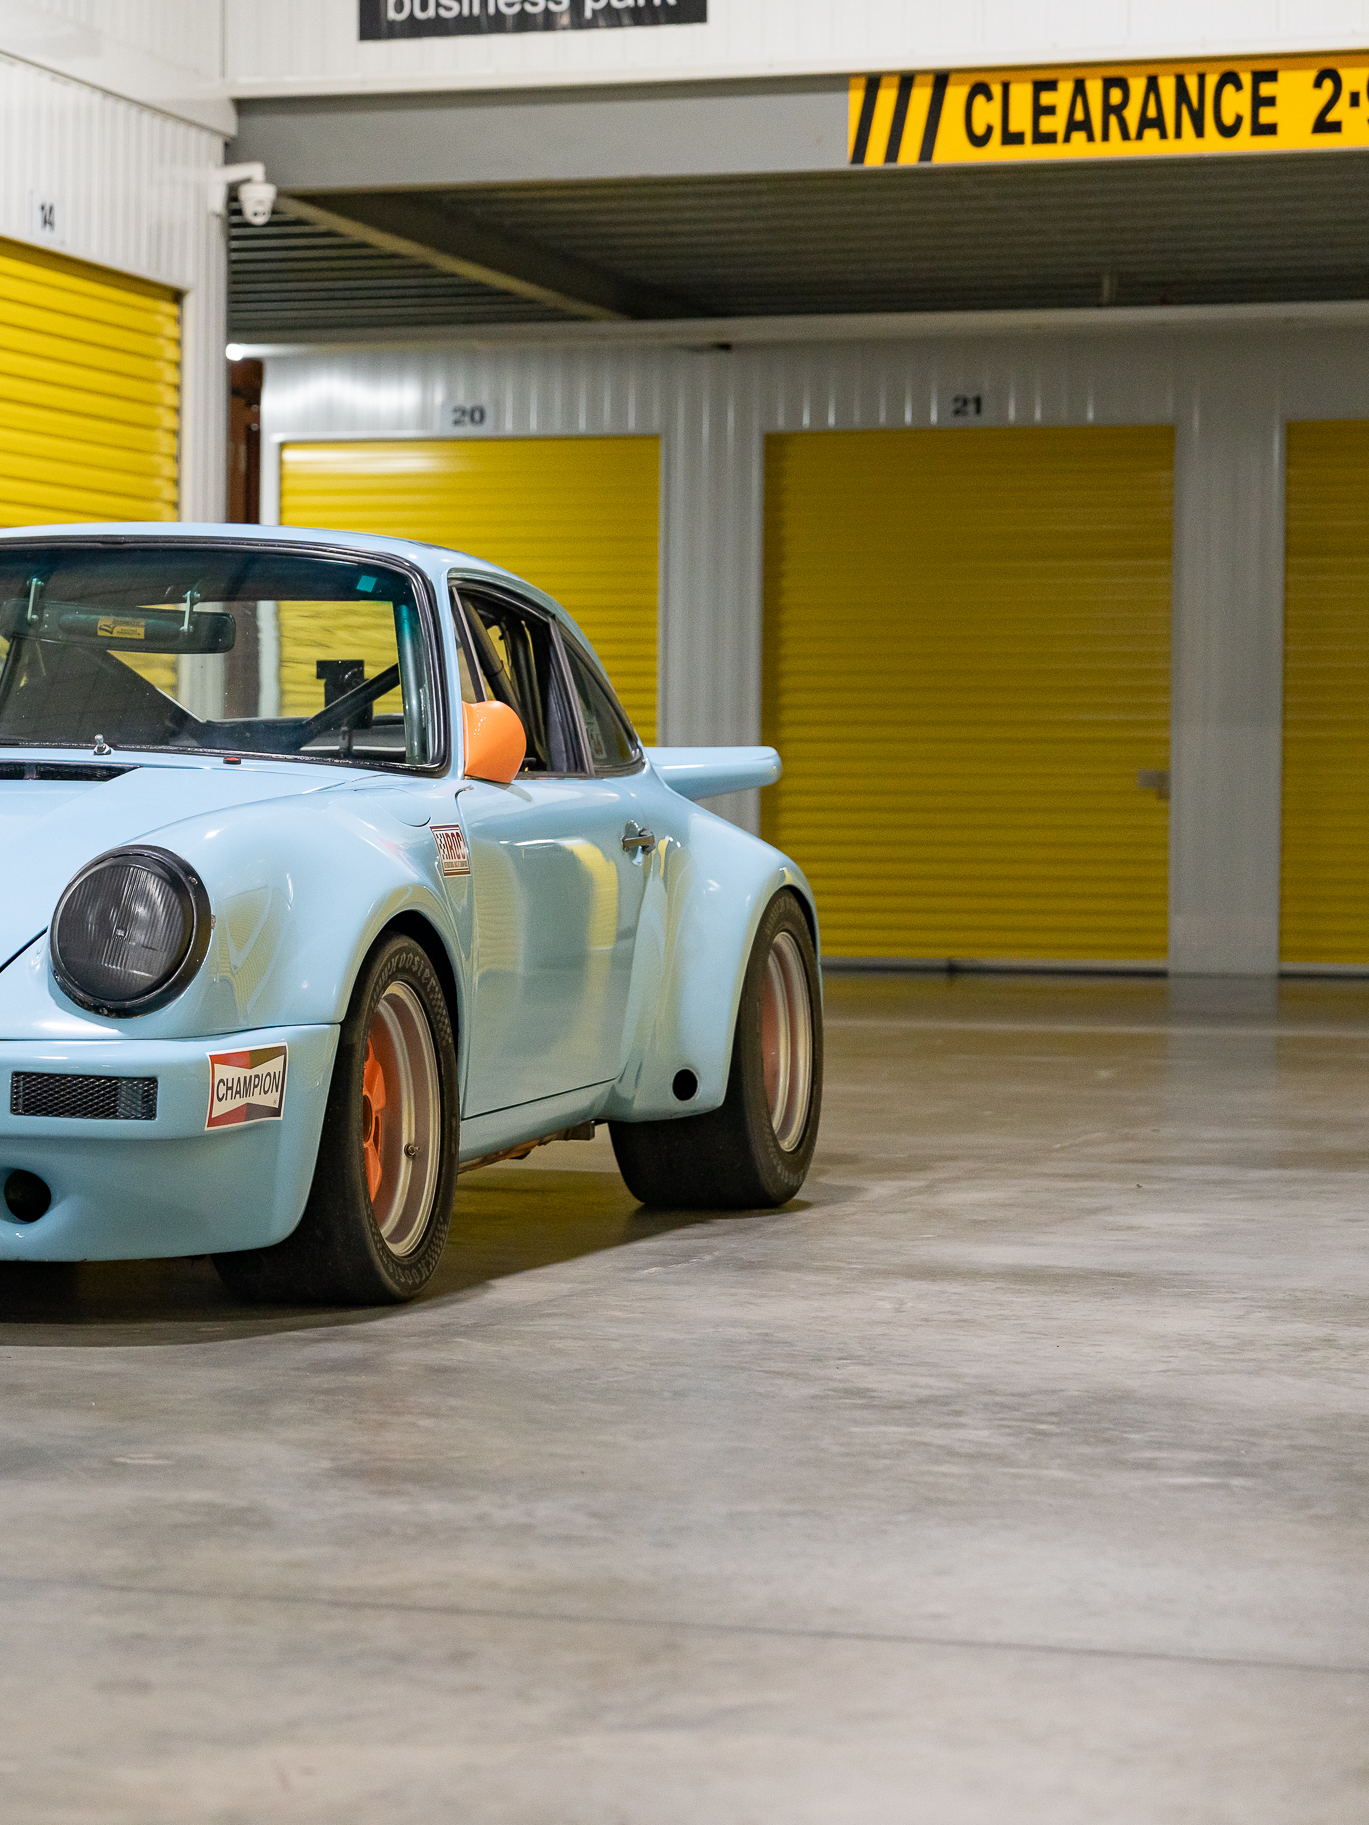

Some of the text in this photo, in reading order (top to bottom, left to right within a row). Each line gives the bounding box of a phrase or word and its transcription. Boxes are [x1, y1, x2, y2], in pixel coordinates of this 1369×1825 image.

[964, 70, 1278, 148] CLEARANCE
[40, 203, 55, 231] 14
[452, 404, 485, 427] 20
[952, 394, 982, 417] 21
[441, 831, 467, 860] IROC
[216, 1070, 281, 1103] CHAMPION
